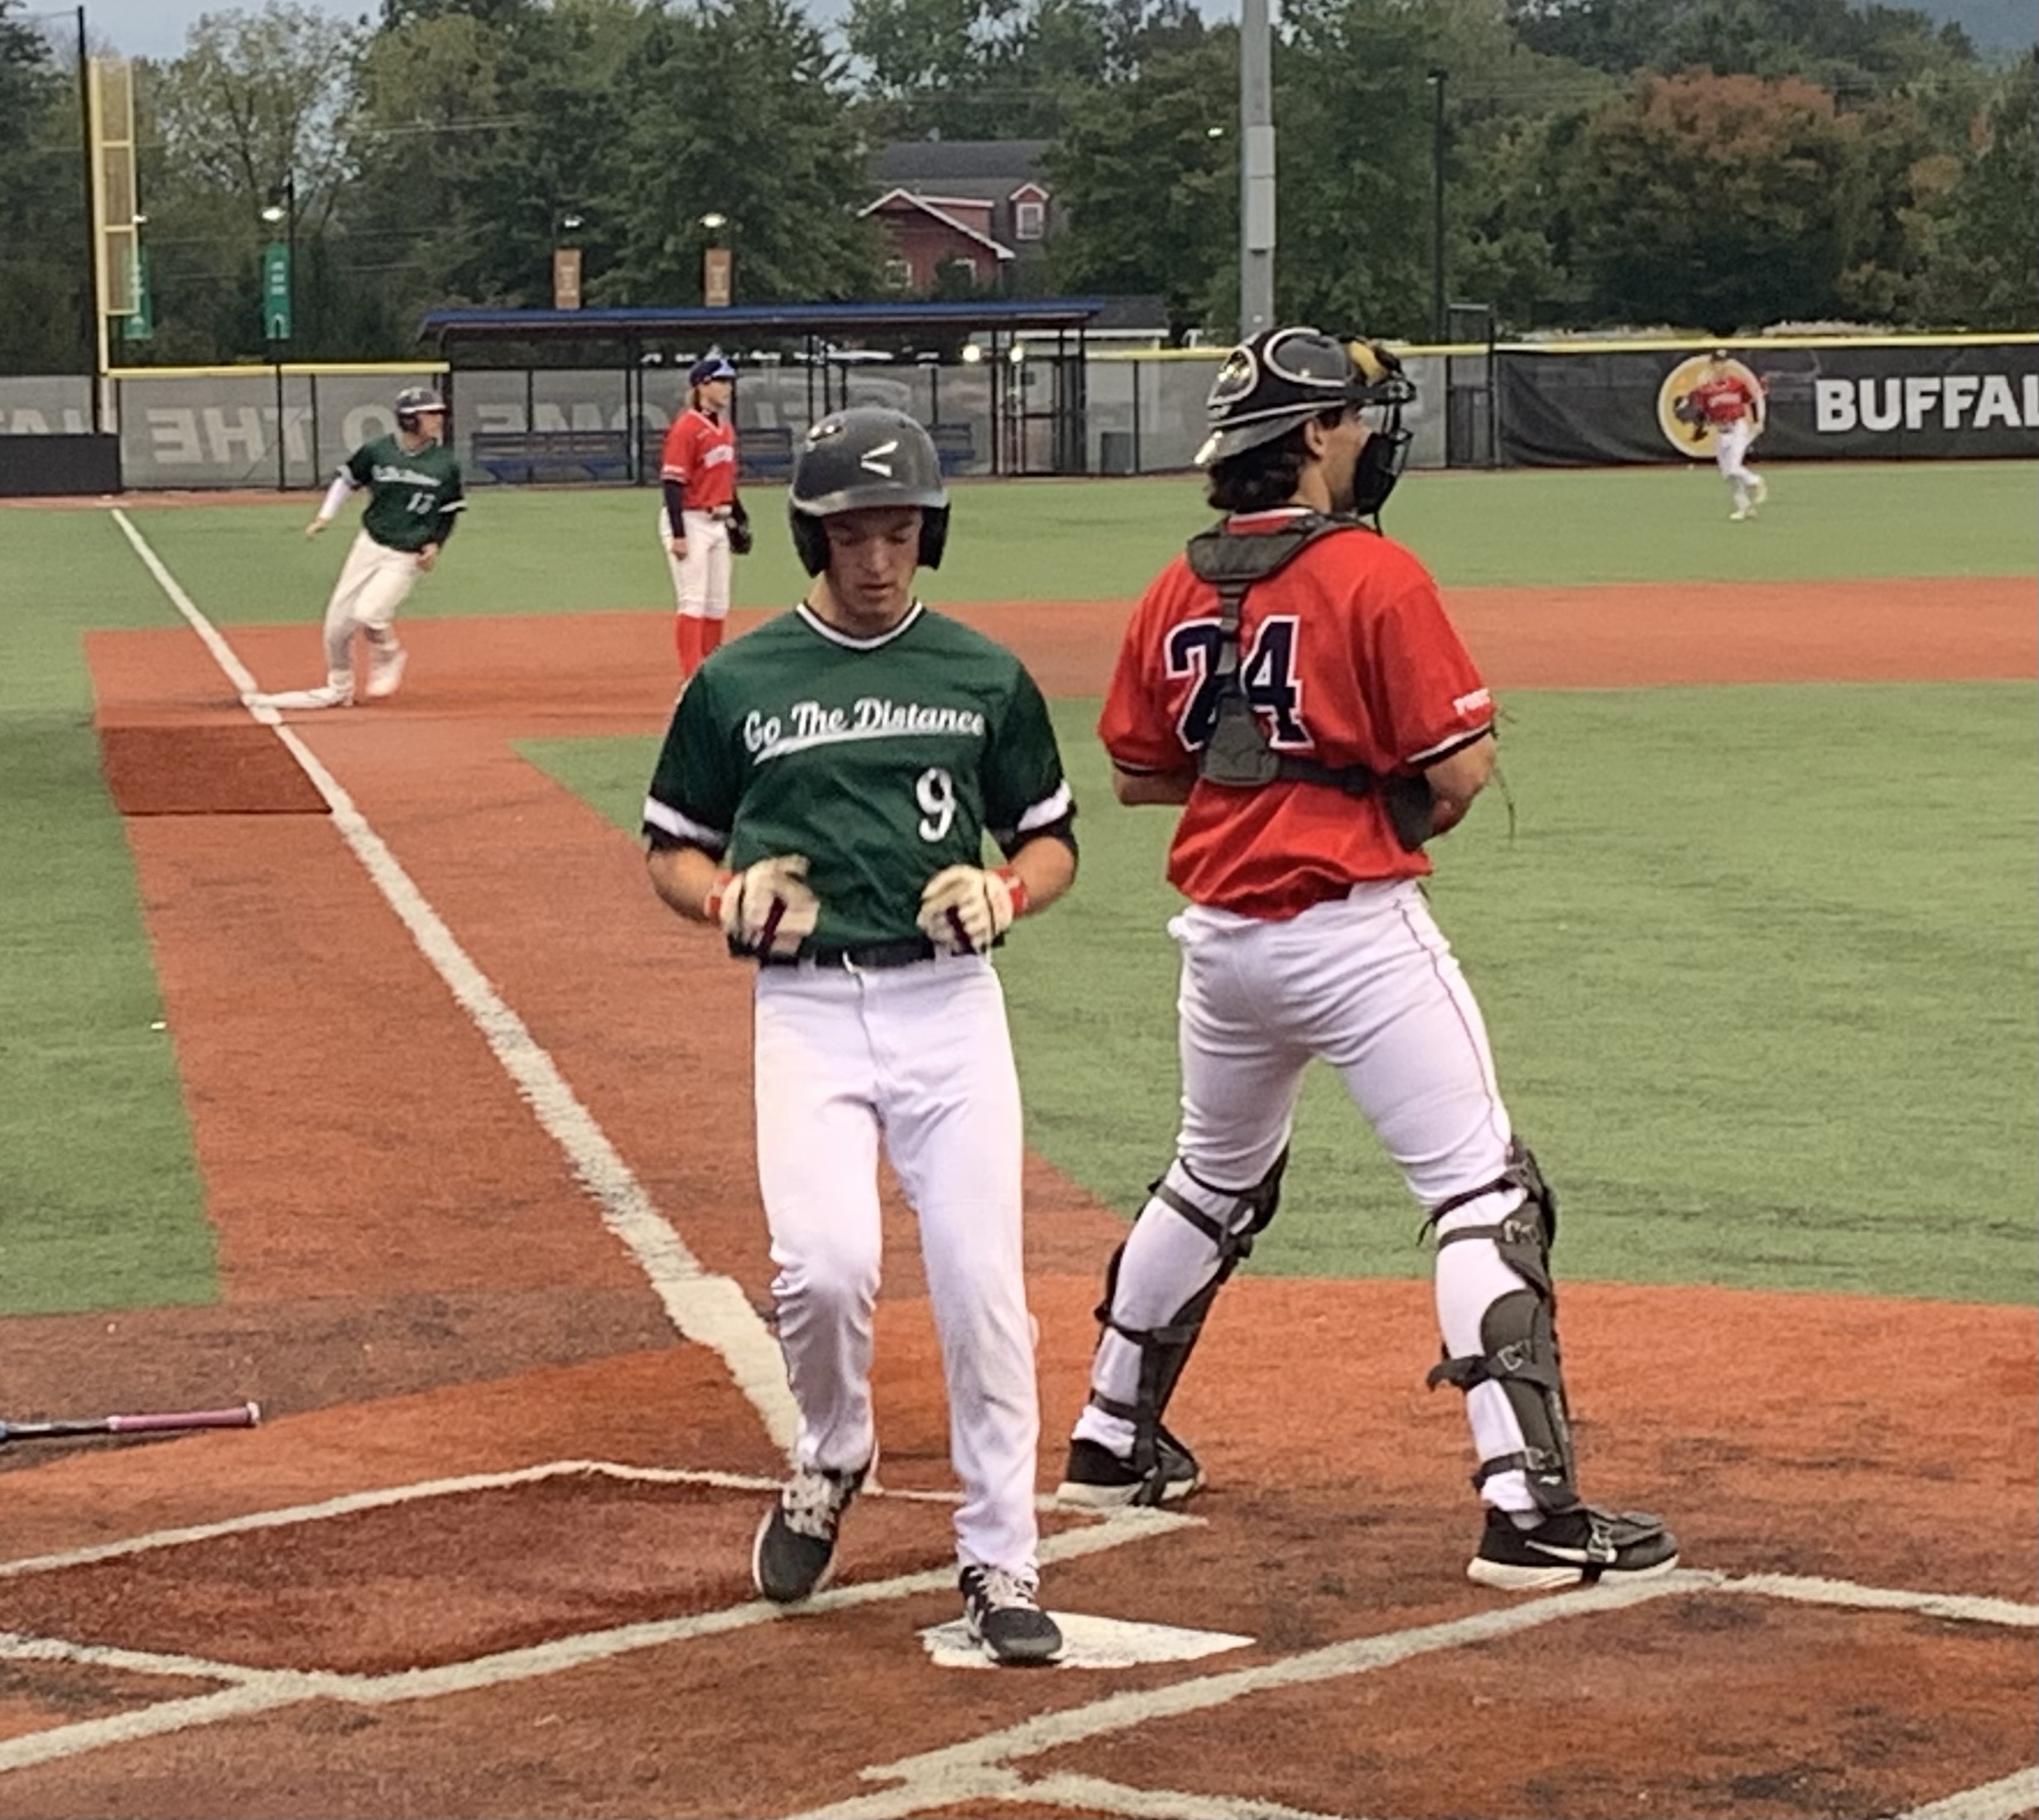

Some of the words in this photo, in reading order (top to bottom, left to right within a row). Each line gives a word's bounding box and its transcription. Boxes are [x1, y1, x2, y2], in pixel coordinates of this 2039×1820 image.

[1163, 614, 1315, 752] 24
[744, 710, 781, 752] Go
[791, 701, 851, 737] The
[854, 698, 985, 737] Distance
[916, 767, 956, 843] 9
